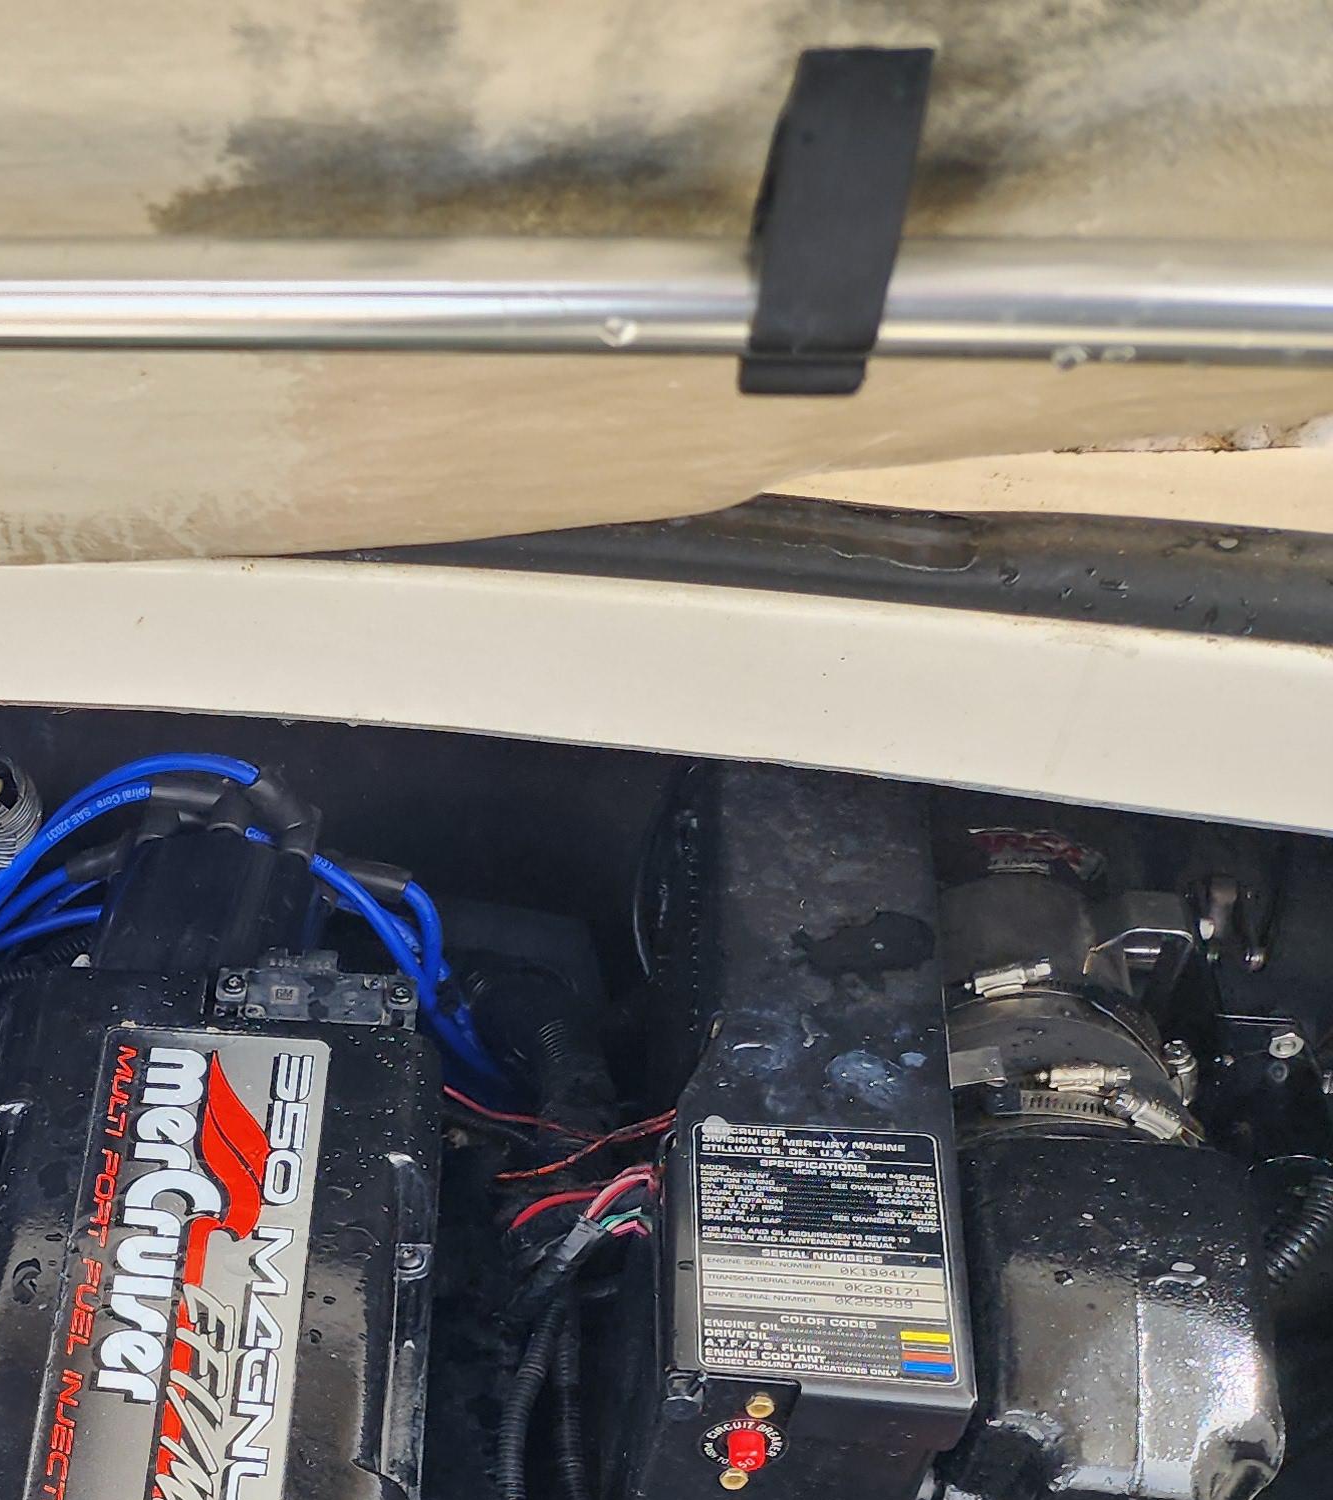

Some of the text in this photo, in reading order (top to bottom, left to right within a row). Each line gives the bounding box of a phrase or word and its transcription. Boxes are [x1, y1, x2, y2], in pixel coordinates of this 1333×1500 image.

[106, 1044, 138, 1138] MULTI
[261, 1052, 313, 1208] 350
[701, 1135, 906, 1152] DIVISION OF MERCURY MARINE
[760, 1159, 867, 1172] SPECIFICATIONS
[842, 1171, 887, 1180] MAGNUM
[739, 1178, 775, 1186] TIMING
[895, 1186, 937, 1194] MANUAL
[755, 1185, 788, 1193] ORDER
[89, 1147, 121, 1248] PORT
[739, 1196, 783, 1205] ROTATION
[760, 1204, 784, 1212] RPM
[701, 1214, 761, 1223] SPARK PLUG
[897, 1218, 940, 1227] MANUAL
[702, 1225, 721, 1233] FOR
[722, 1226, 746, 1234] FUEL
[788, 1230, 863, 1241] REQUIREMENTS
[864, 1234, 896, 1242] REFER
[702, 1232, 850, 1246] OPERATION AND MAINTENANCE
[706, 1257, 822, 1270] ENGINE SERIAL NUMBER
[761, 1249, 883, 1264] SERIAL NUMBERS
[708, 1273, 835, 1287] TRANSOM SERIAL NUMBER
[737, 1292, 770, 1300] SERIAL
[773, 1295, 816, 1303] NUMBER
[65, 1257, 103, 1355] FUEL
[704, 1319, 757, 1330] ENGINE
[780, 1315, 877, 1330] COLOR CODES
[704, 1329, 745, 1339] DRIVE
[782, 1342, 822, 1354] FLUID
[705, 1349, 827, 1364] ENGINE COOLANT
[705, 1357, 899, 1377] CLOSED COOLING APPLICATIONS ONLY
[706, 1421, 784, 1457] CIRCUIT BREAKER
